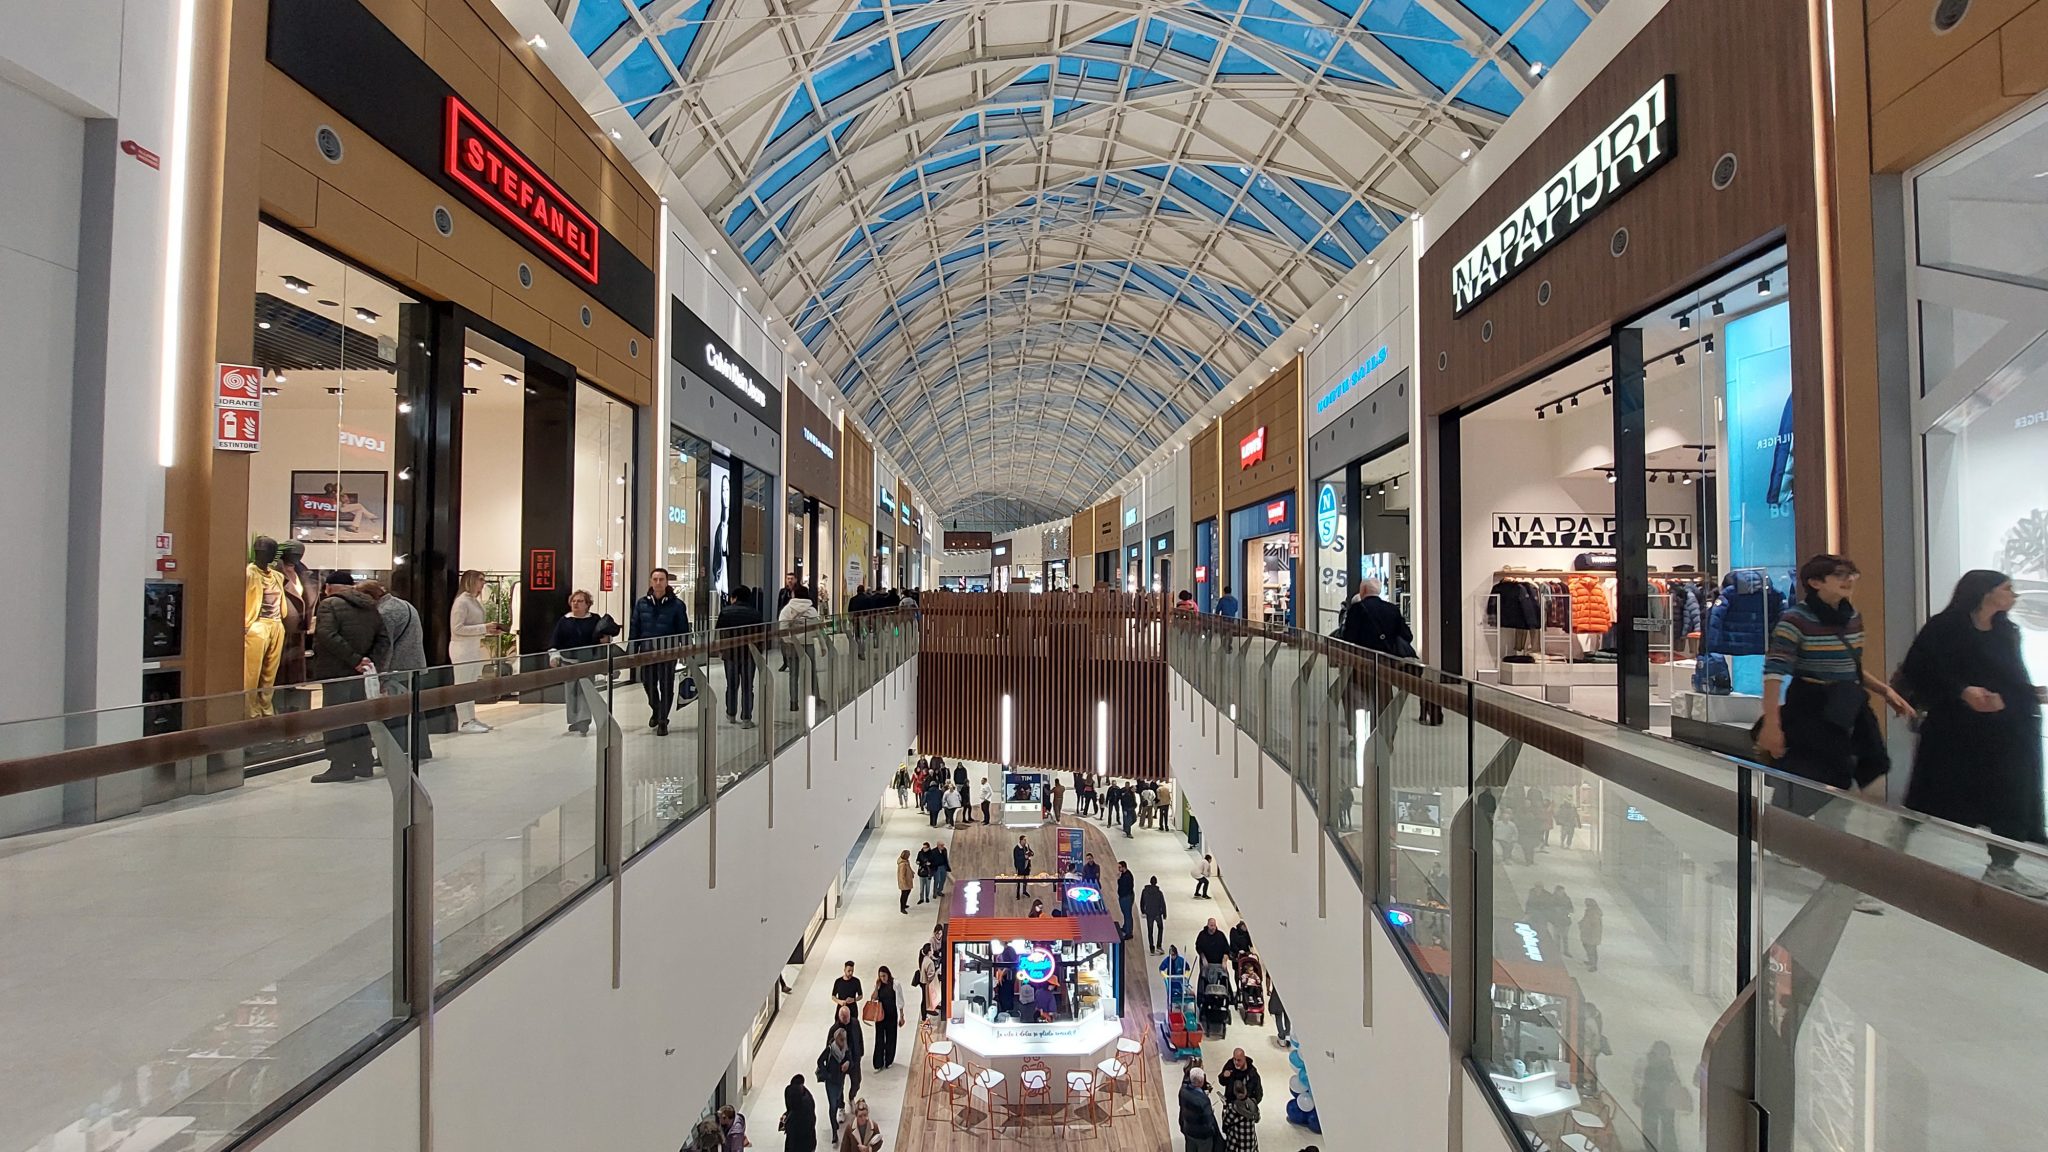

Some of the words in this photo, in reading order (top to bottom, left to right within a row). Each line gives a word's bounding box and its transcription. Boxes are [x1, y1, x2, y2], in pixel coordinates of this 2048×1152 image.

[464, 138, 591, 260] STEFANEL
[1454, 86, 1664, 314] NAPAPIJRI
[705, 343, 731, 380] Calvin
[1317, 377, 1351, 415] NORTH
[1350, 345, 1388, 387] SAILS
[219, 398, 260, 408] IDRANTE
[219, 441, 258, 450] ESTINTORE
[1322, 493, 1332, 511] N
[1322, 520, 1332, 536] S
[1496, 516, 1689, 547] NAPAPRI
